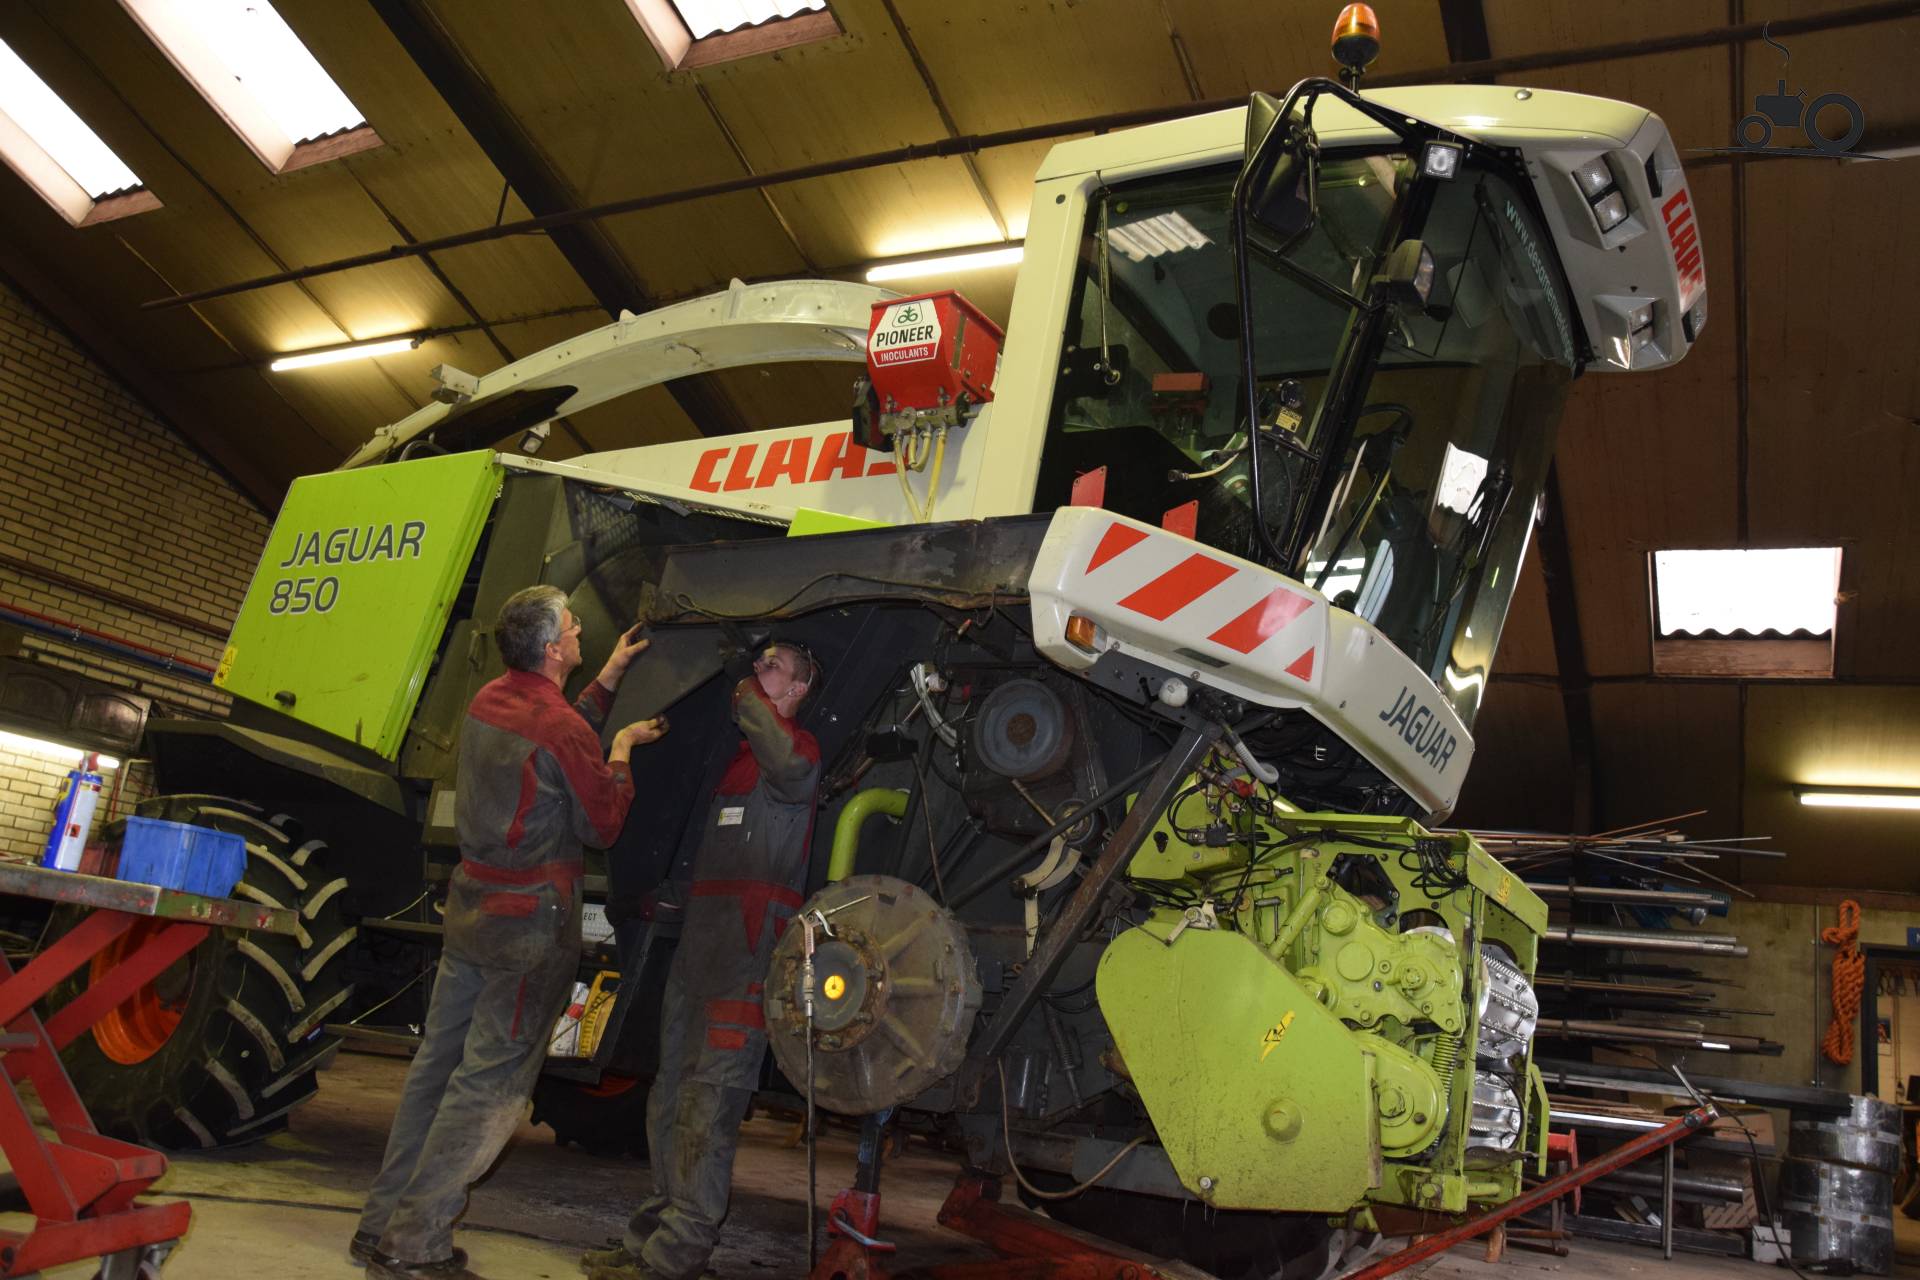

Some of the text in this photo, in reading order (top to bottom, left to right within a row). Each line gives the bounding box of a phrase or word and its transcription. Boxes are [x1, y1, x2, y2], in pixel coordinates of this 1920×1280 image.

[1661, 187, 1704, 296] CLAAS
[876, 325, 934, 347] PIONEER
[880, 347, 929, 362] INOCULANTS
[280, 520, 426, 569] JAGUAR
[269, 576, 340, 616] 850
[1379, 686, 1456, 774] JAGUAR
